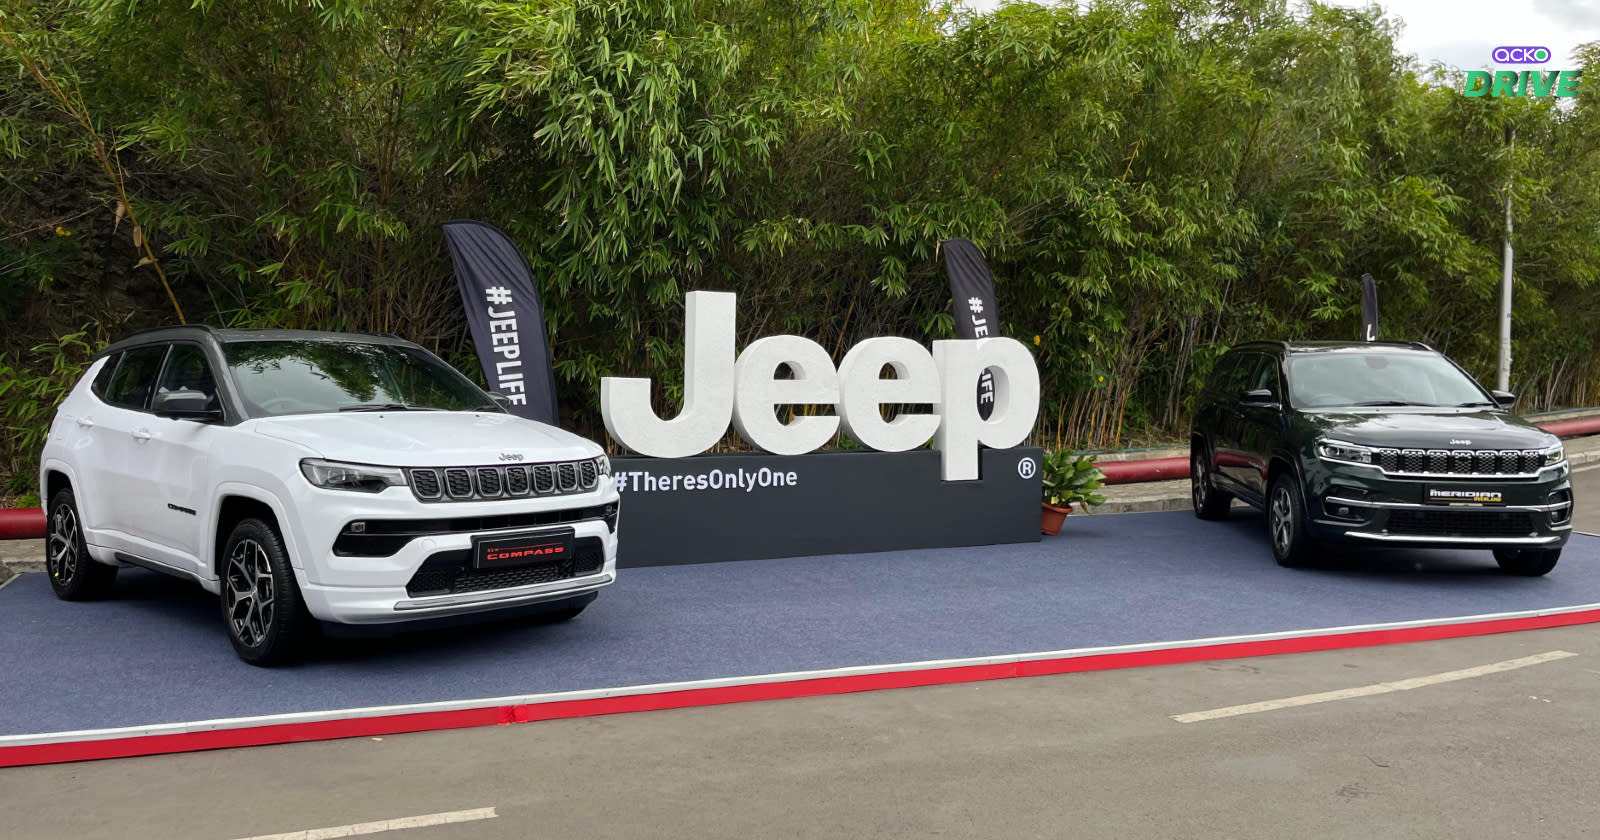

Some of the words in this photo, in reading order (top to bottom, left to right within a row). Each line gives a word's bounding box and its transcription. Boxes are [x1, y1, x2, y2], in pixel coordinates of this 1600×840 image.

[600, 290, 1041, 481] Jeep
[1450, 438, 1472, 446] Jeep
[499, 452, 524, 462] Jeep
[613, 467, 798, 492] #TheresOnlyOne
[487, 547, 564, 560] COMPASS
